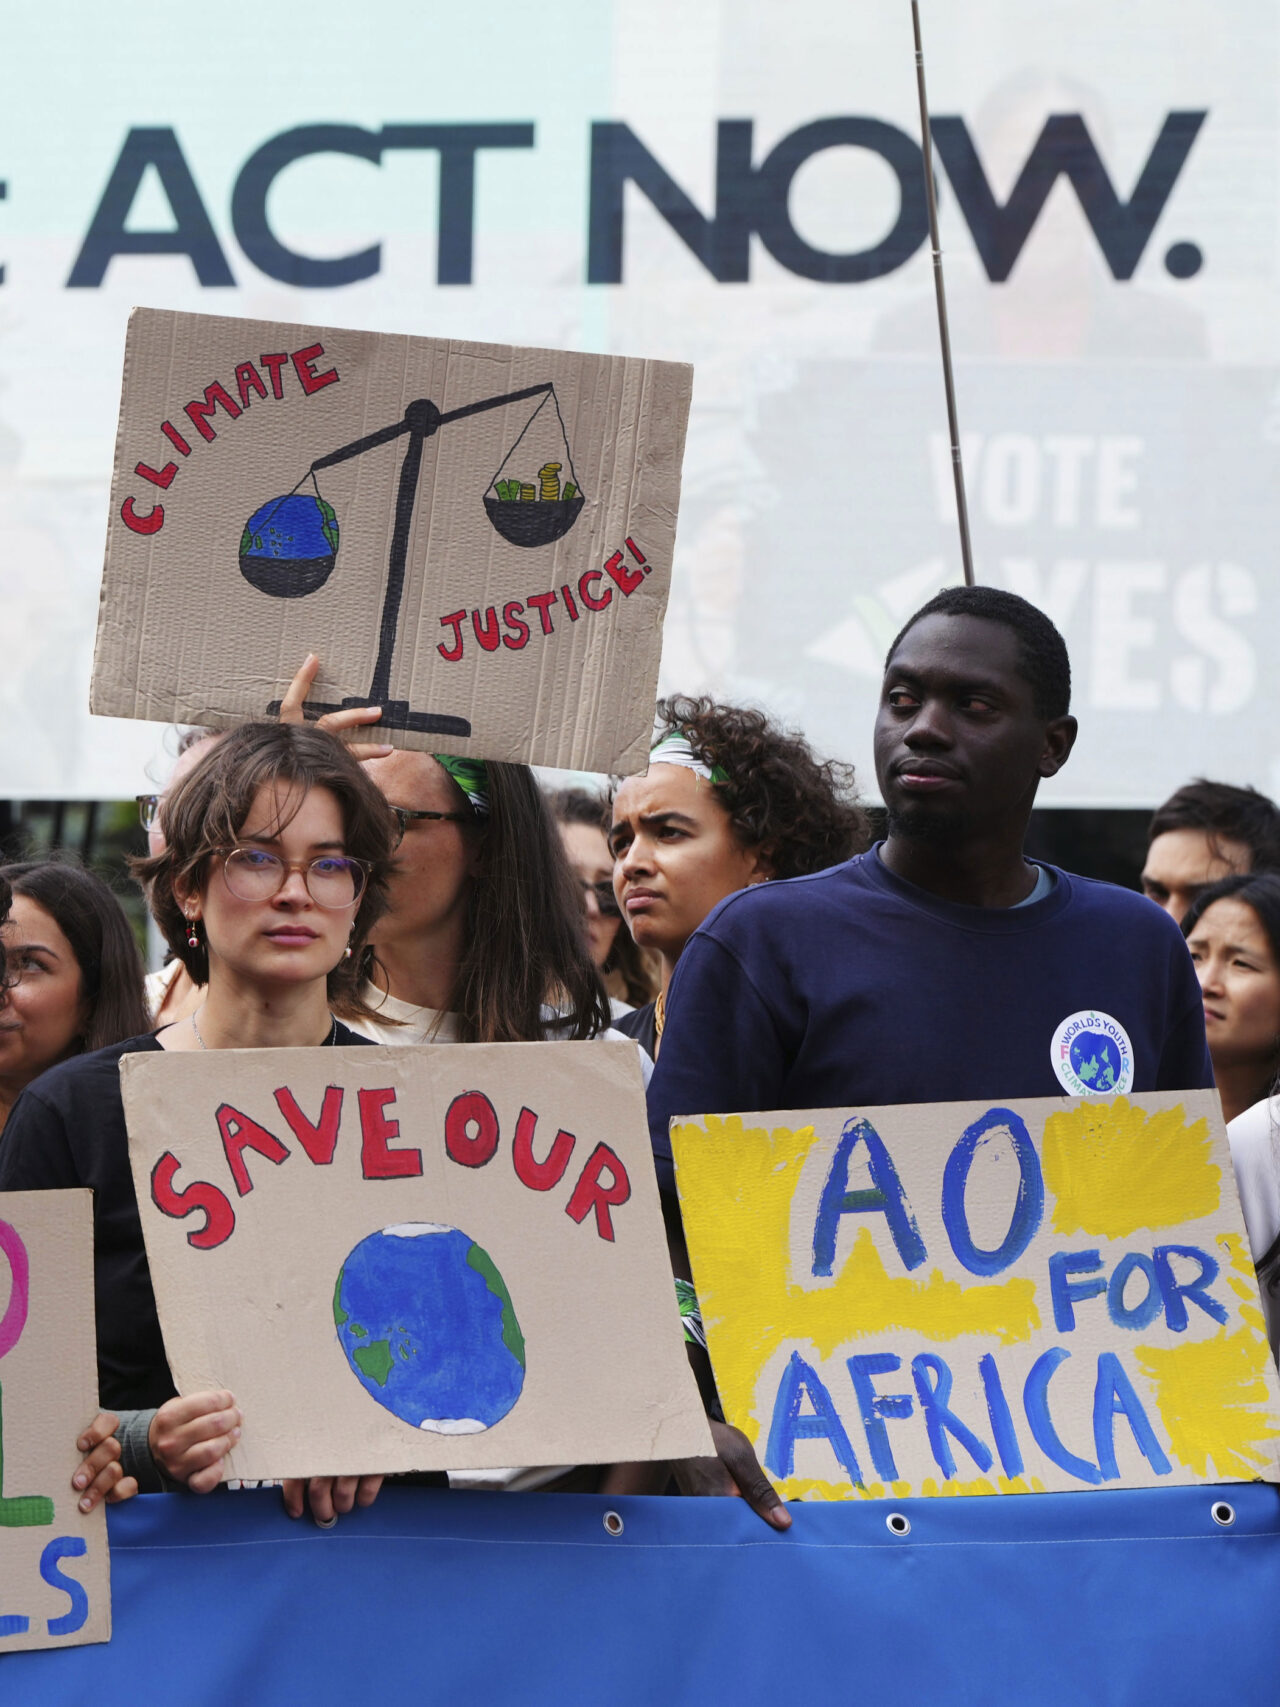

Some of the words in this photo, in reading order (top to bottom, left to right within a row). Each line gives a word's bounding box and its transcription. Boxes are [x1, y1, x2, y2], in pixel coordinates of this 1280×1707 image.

[65, 120, 537, 289] ACT
[585, 110, 1208, 287] NOW.
[120, 342, 339, 535] CLIMATE
[927, 431, 1145, 529] VOTE
[437, 536, 652, 662] JUSTICE!
[1103, 1020, 1128, 1055] YOUTH
[150, 1083, 424, 1251] SAVE
[444, 1089, 631, 1242] OUR
[811, 1106, 1047, 1278] AO
[1048, 1243, 1231, 1333] FOR
[763, 1346, 1174, 1488] AFRICA
